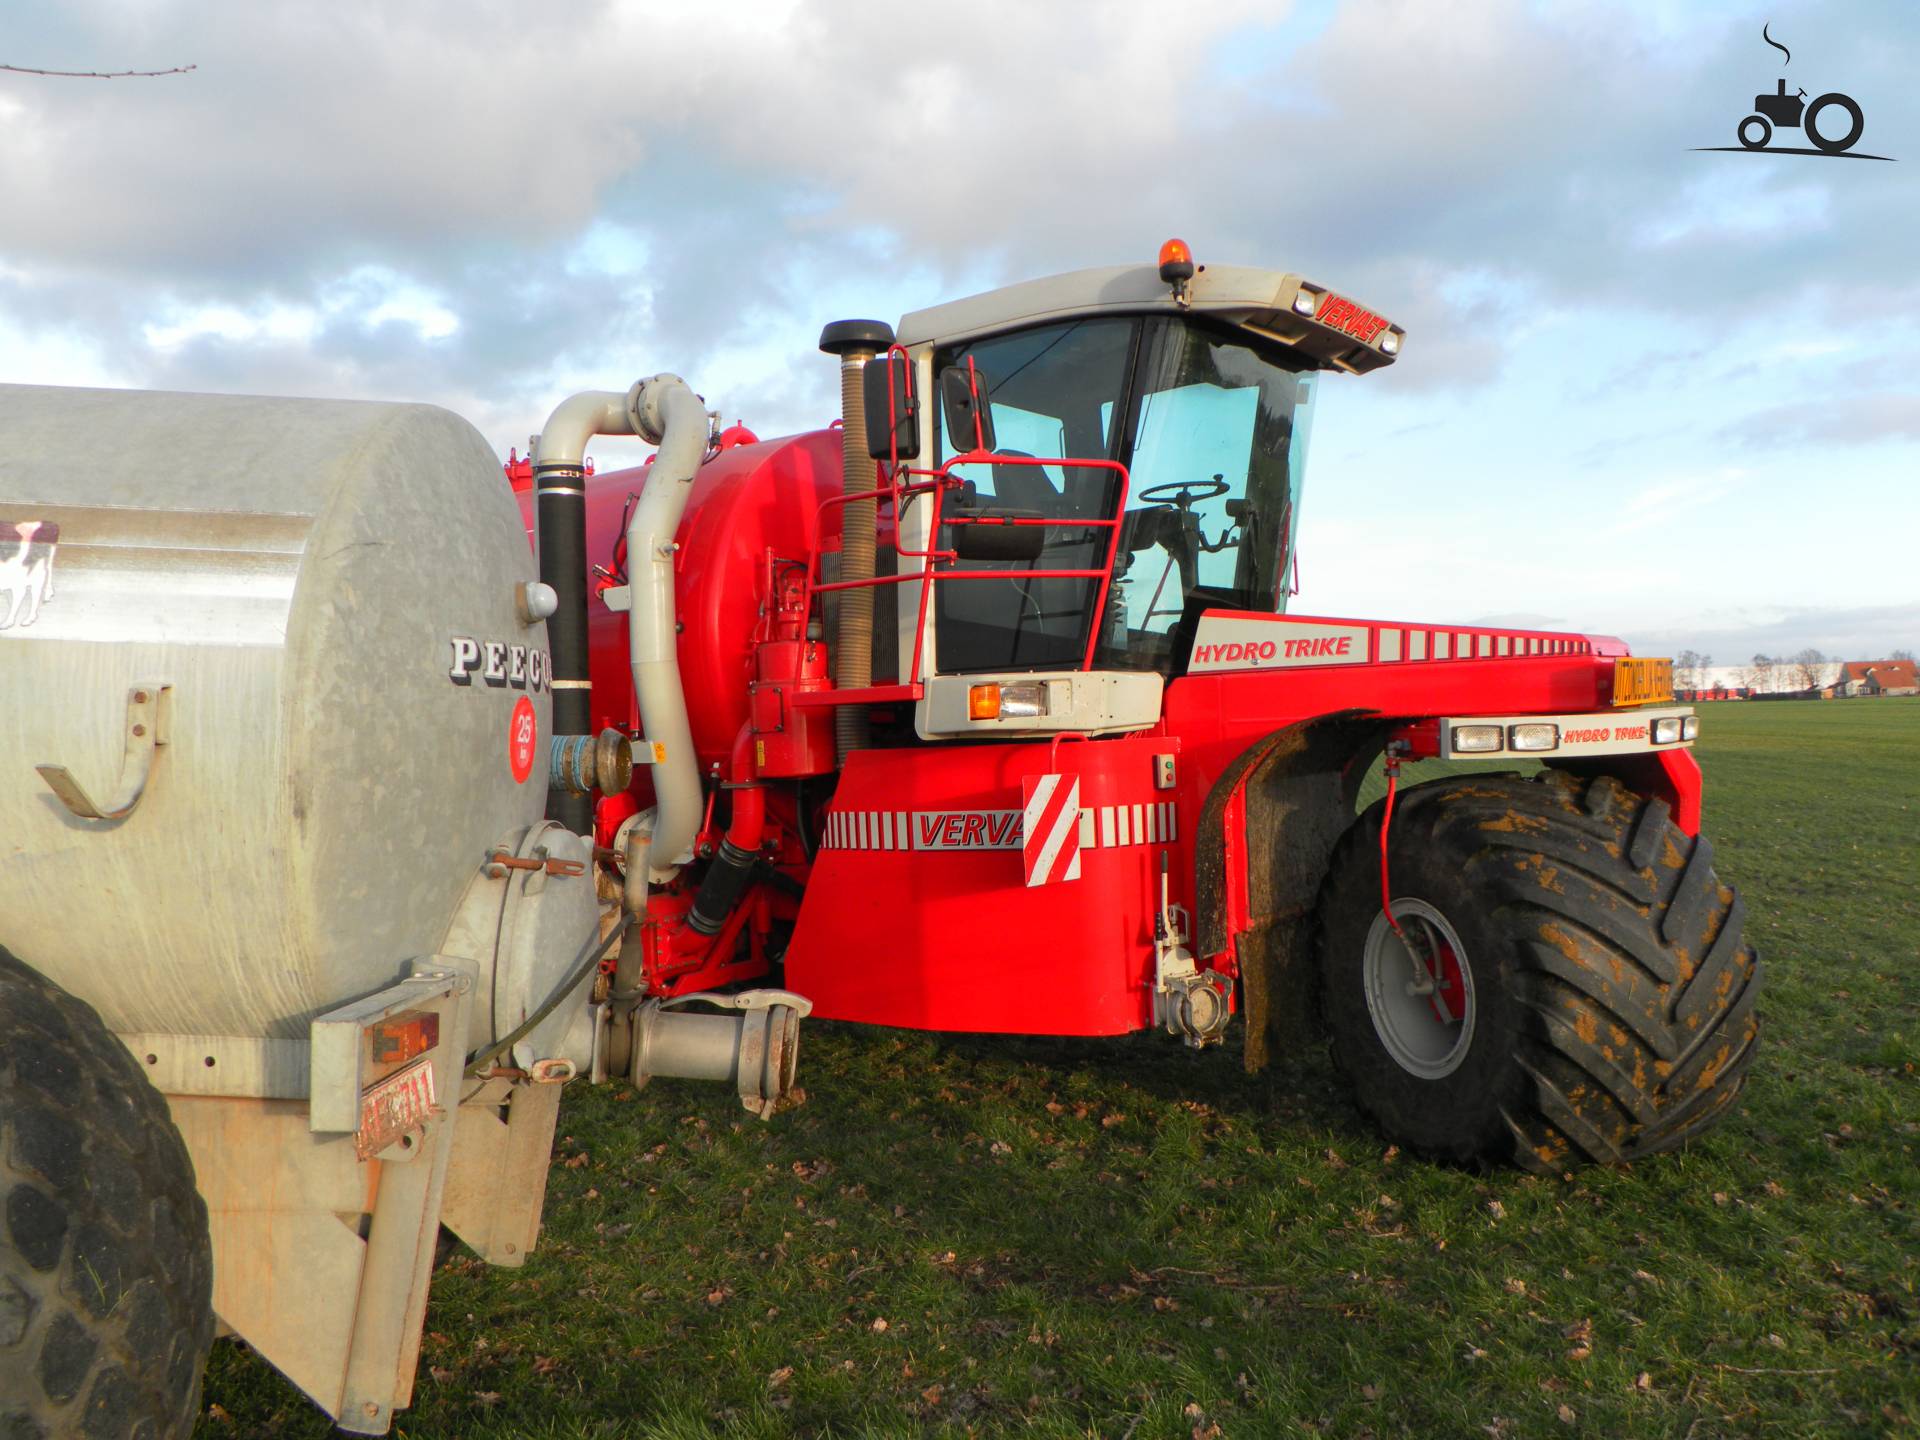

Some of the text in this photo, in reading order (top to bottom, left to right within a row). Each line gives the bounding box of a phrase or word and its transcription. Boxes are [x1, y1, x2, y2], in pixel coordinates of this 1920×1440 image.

[1315, 293, 1391, 344] VERVAET
[1194, 636, 1353, 664] HYDRO TRIKE
[517, 715, 531, 744] 25
[1564, 726, 1646, 743] HYDRO TRIKE
